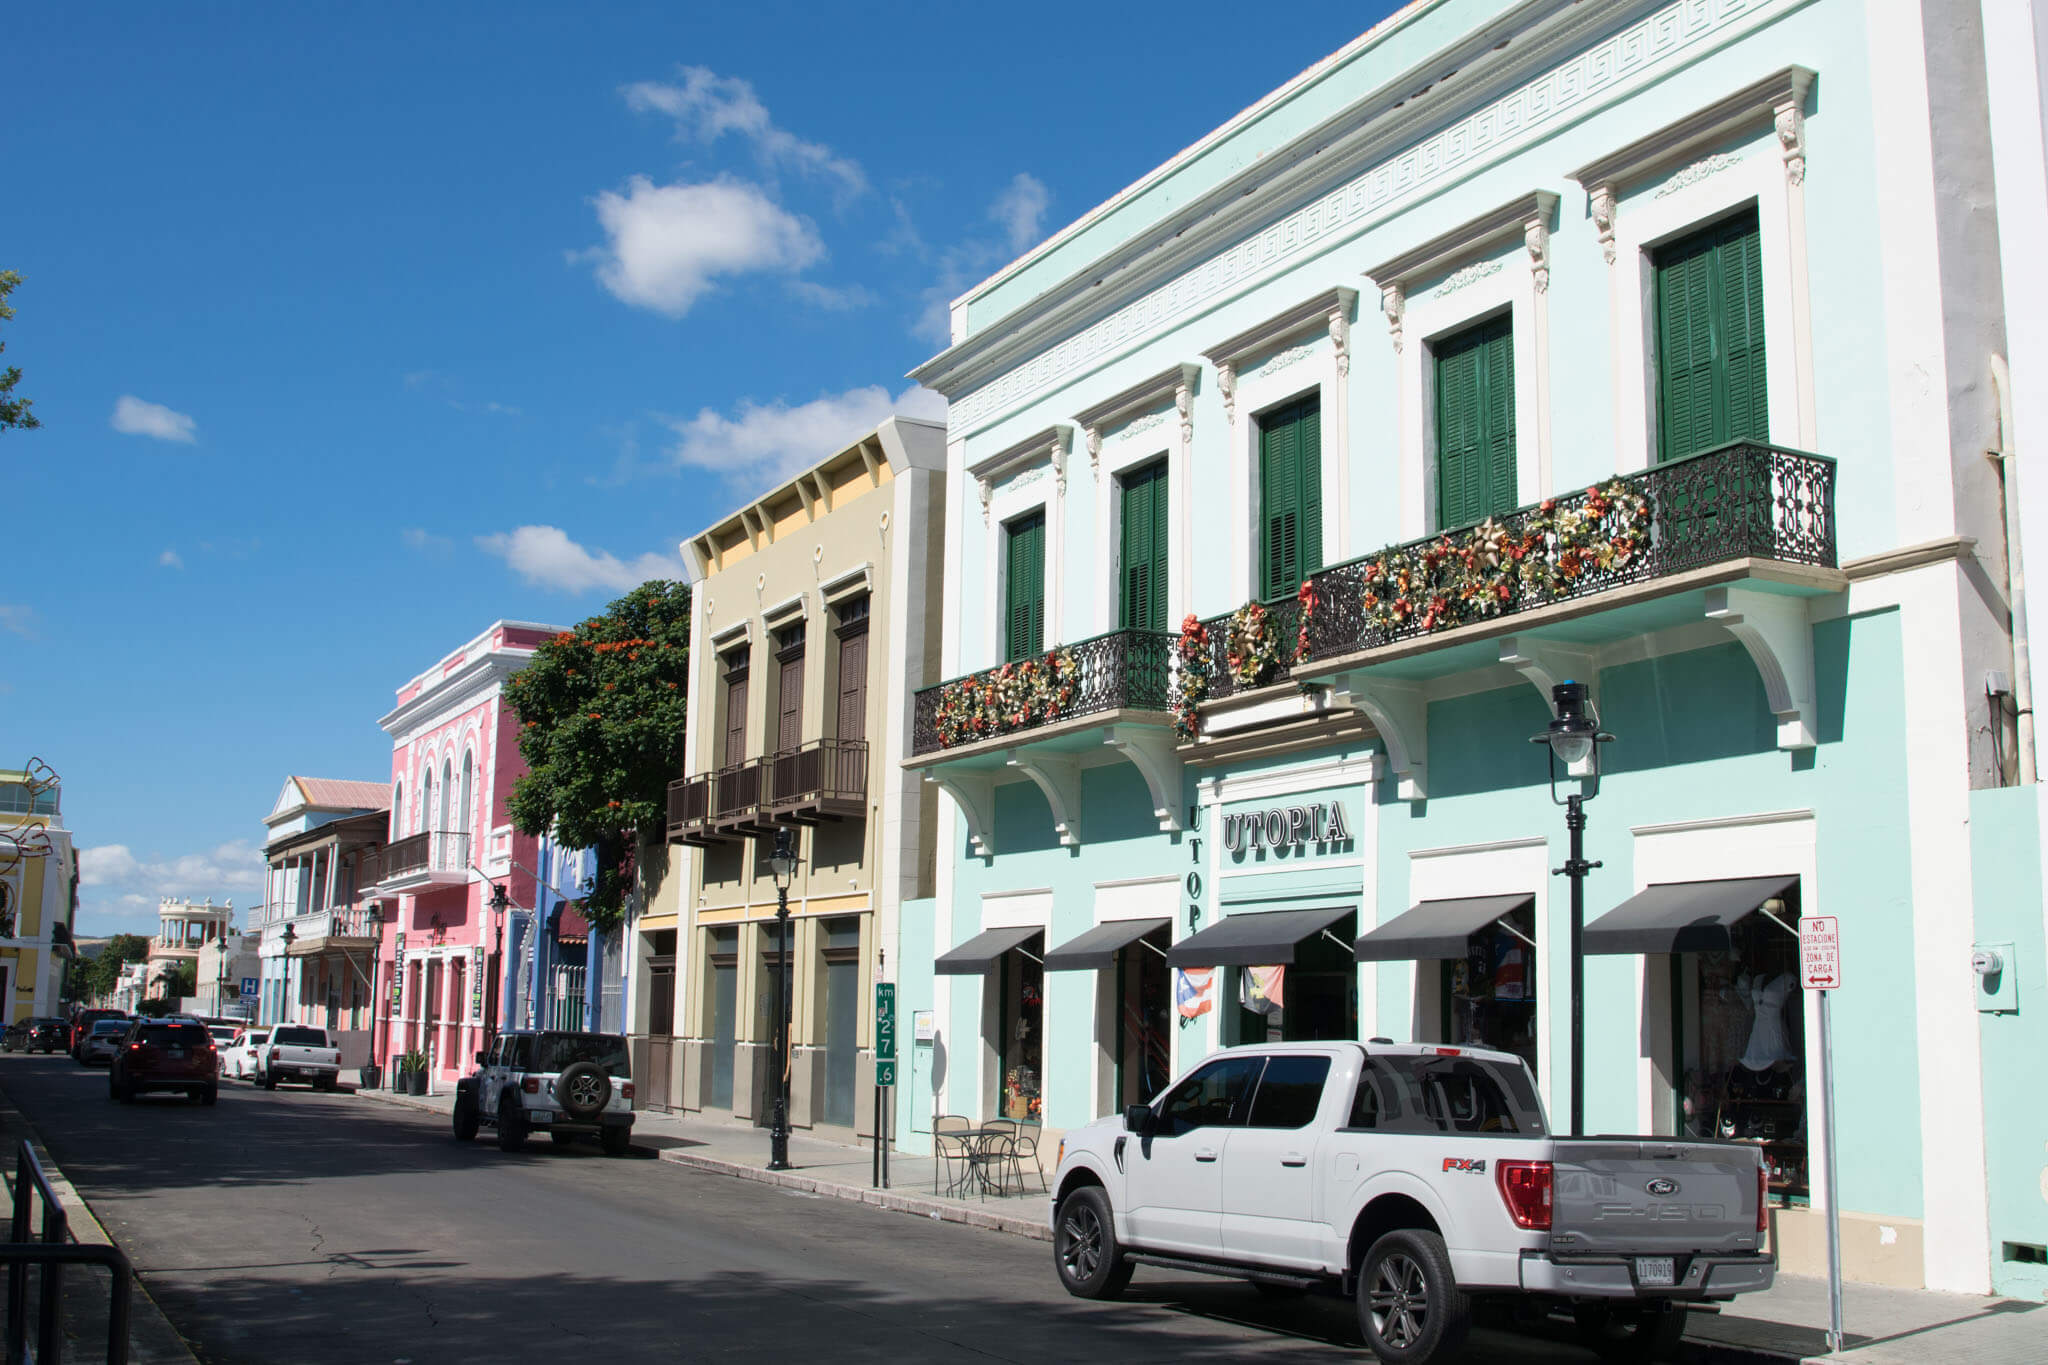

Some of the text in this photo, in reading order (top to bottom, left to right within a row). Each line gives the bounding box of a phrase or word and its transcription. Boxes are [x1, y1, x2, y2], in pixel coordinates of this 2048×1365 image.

[1223, 801, 1347, 851] UTOPIA
[1187, 805, 1202, 936] UTOP
[1812, 921, 1825, 932] NO
[1802, 934, 1835, 944] ESTACIONE
[1806, 952, 1834, 962] ZONA DE
[1808, 964, 1833, 973] CARGA
[244, 979, 257, 993] H
[878, 987, 894, 997] km
[1442, 1158, 1486, 1171] FX4
